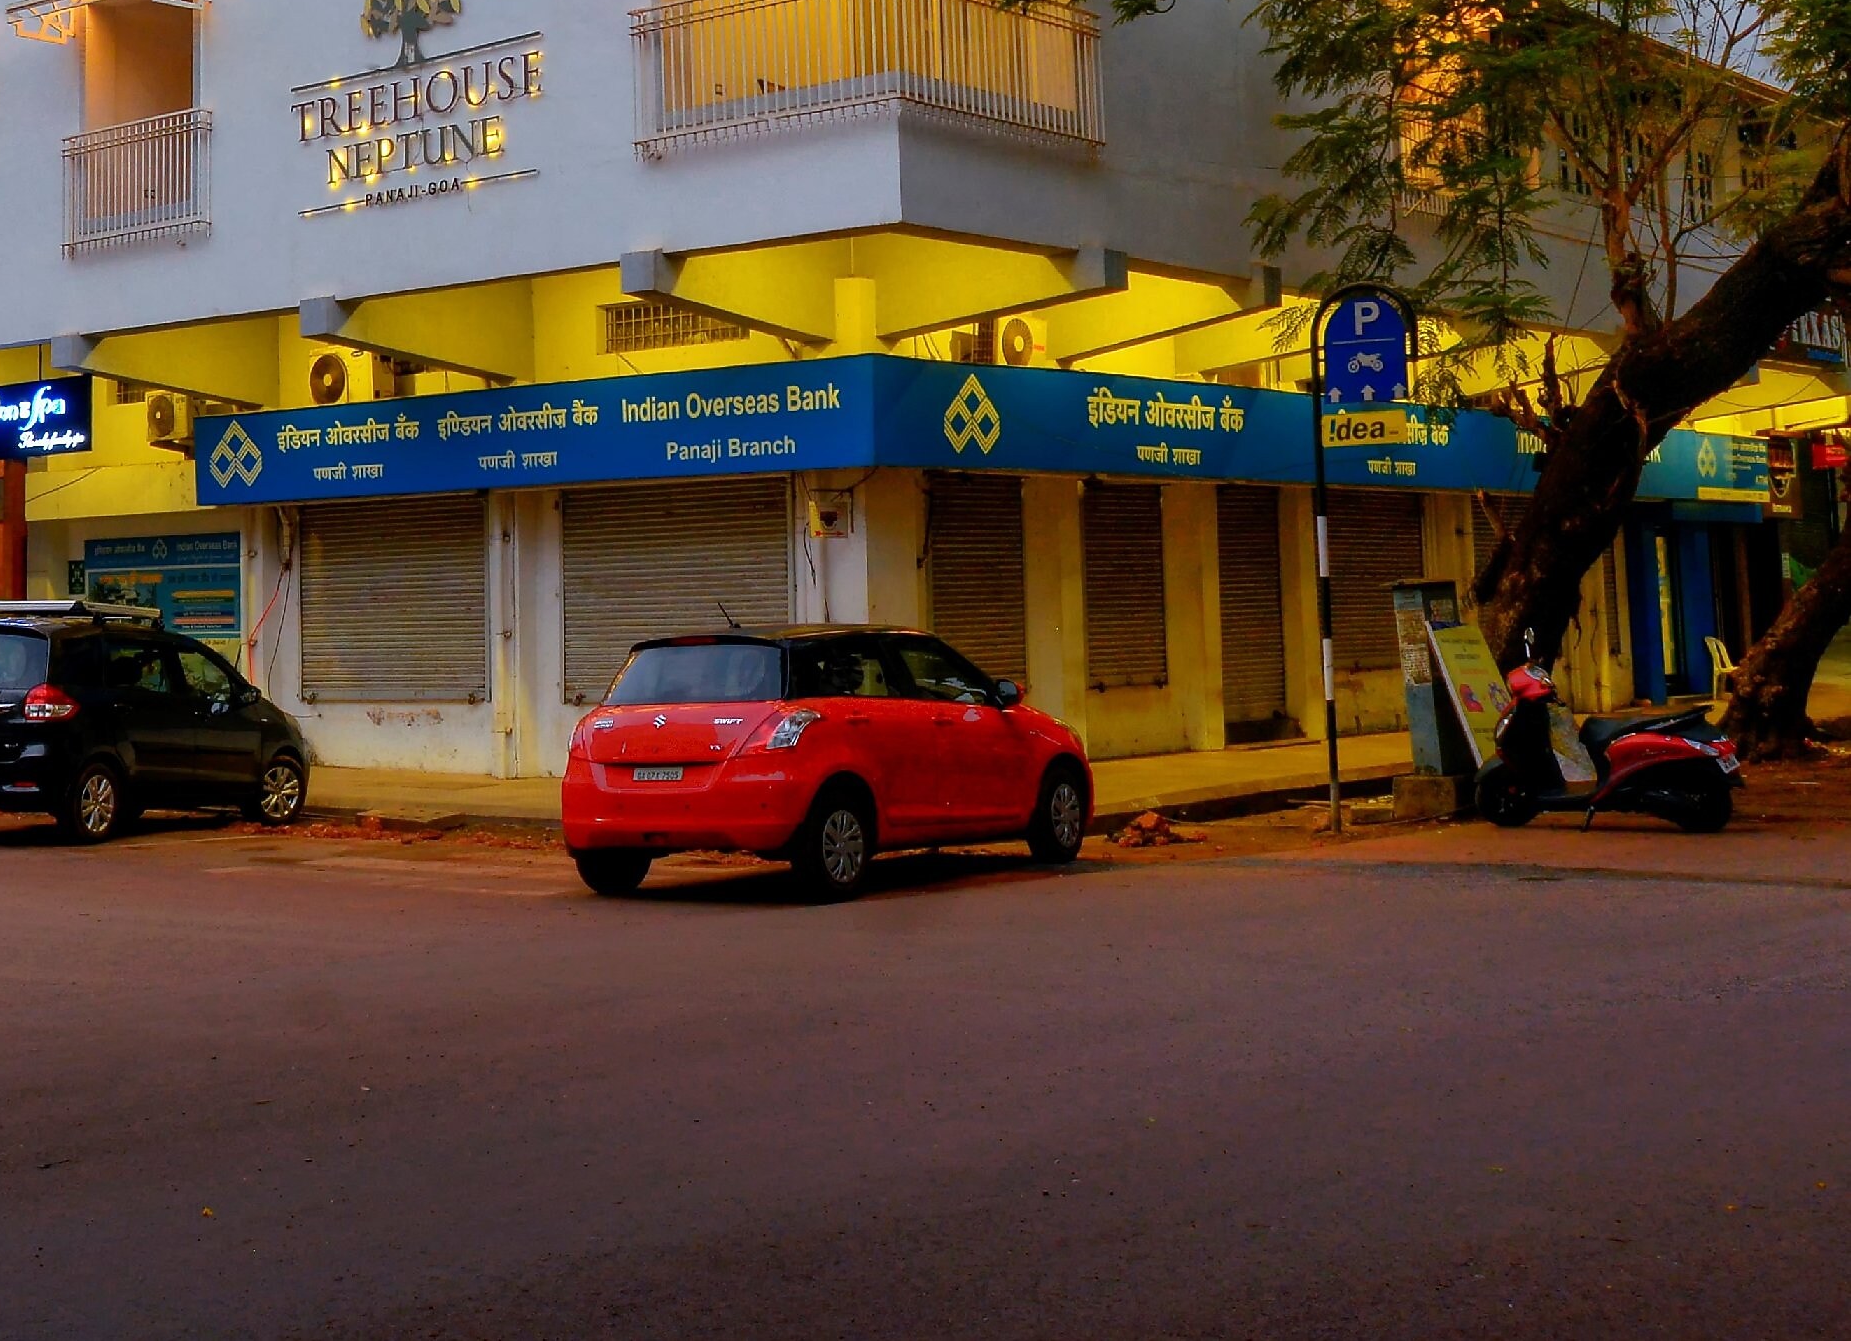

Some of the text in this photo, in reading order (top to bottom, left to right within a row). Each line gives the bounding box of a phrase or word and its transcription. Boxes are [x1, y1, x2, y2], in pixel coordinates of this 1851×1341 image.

[291, 51, 543, 142] TREEHOUSE
[326, 115, 504, 184] NEPTUNE
[1354, 301, 1380, 335] P
[622, 383, 841, 423] Indian Overseas Bank
[1087, 387, 1139, 428] इंडियन
[277, 424, 321, 452] इंडियन
[666, 435, 796, 464] Panaji Branch
[479, 450, 558, 470] पणजी शाखा
[1136, 442, 1201, 466] पणजी शाखा
[314, 462, 384, 481] पणजी शाखा
